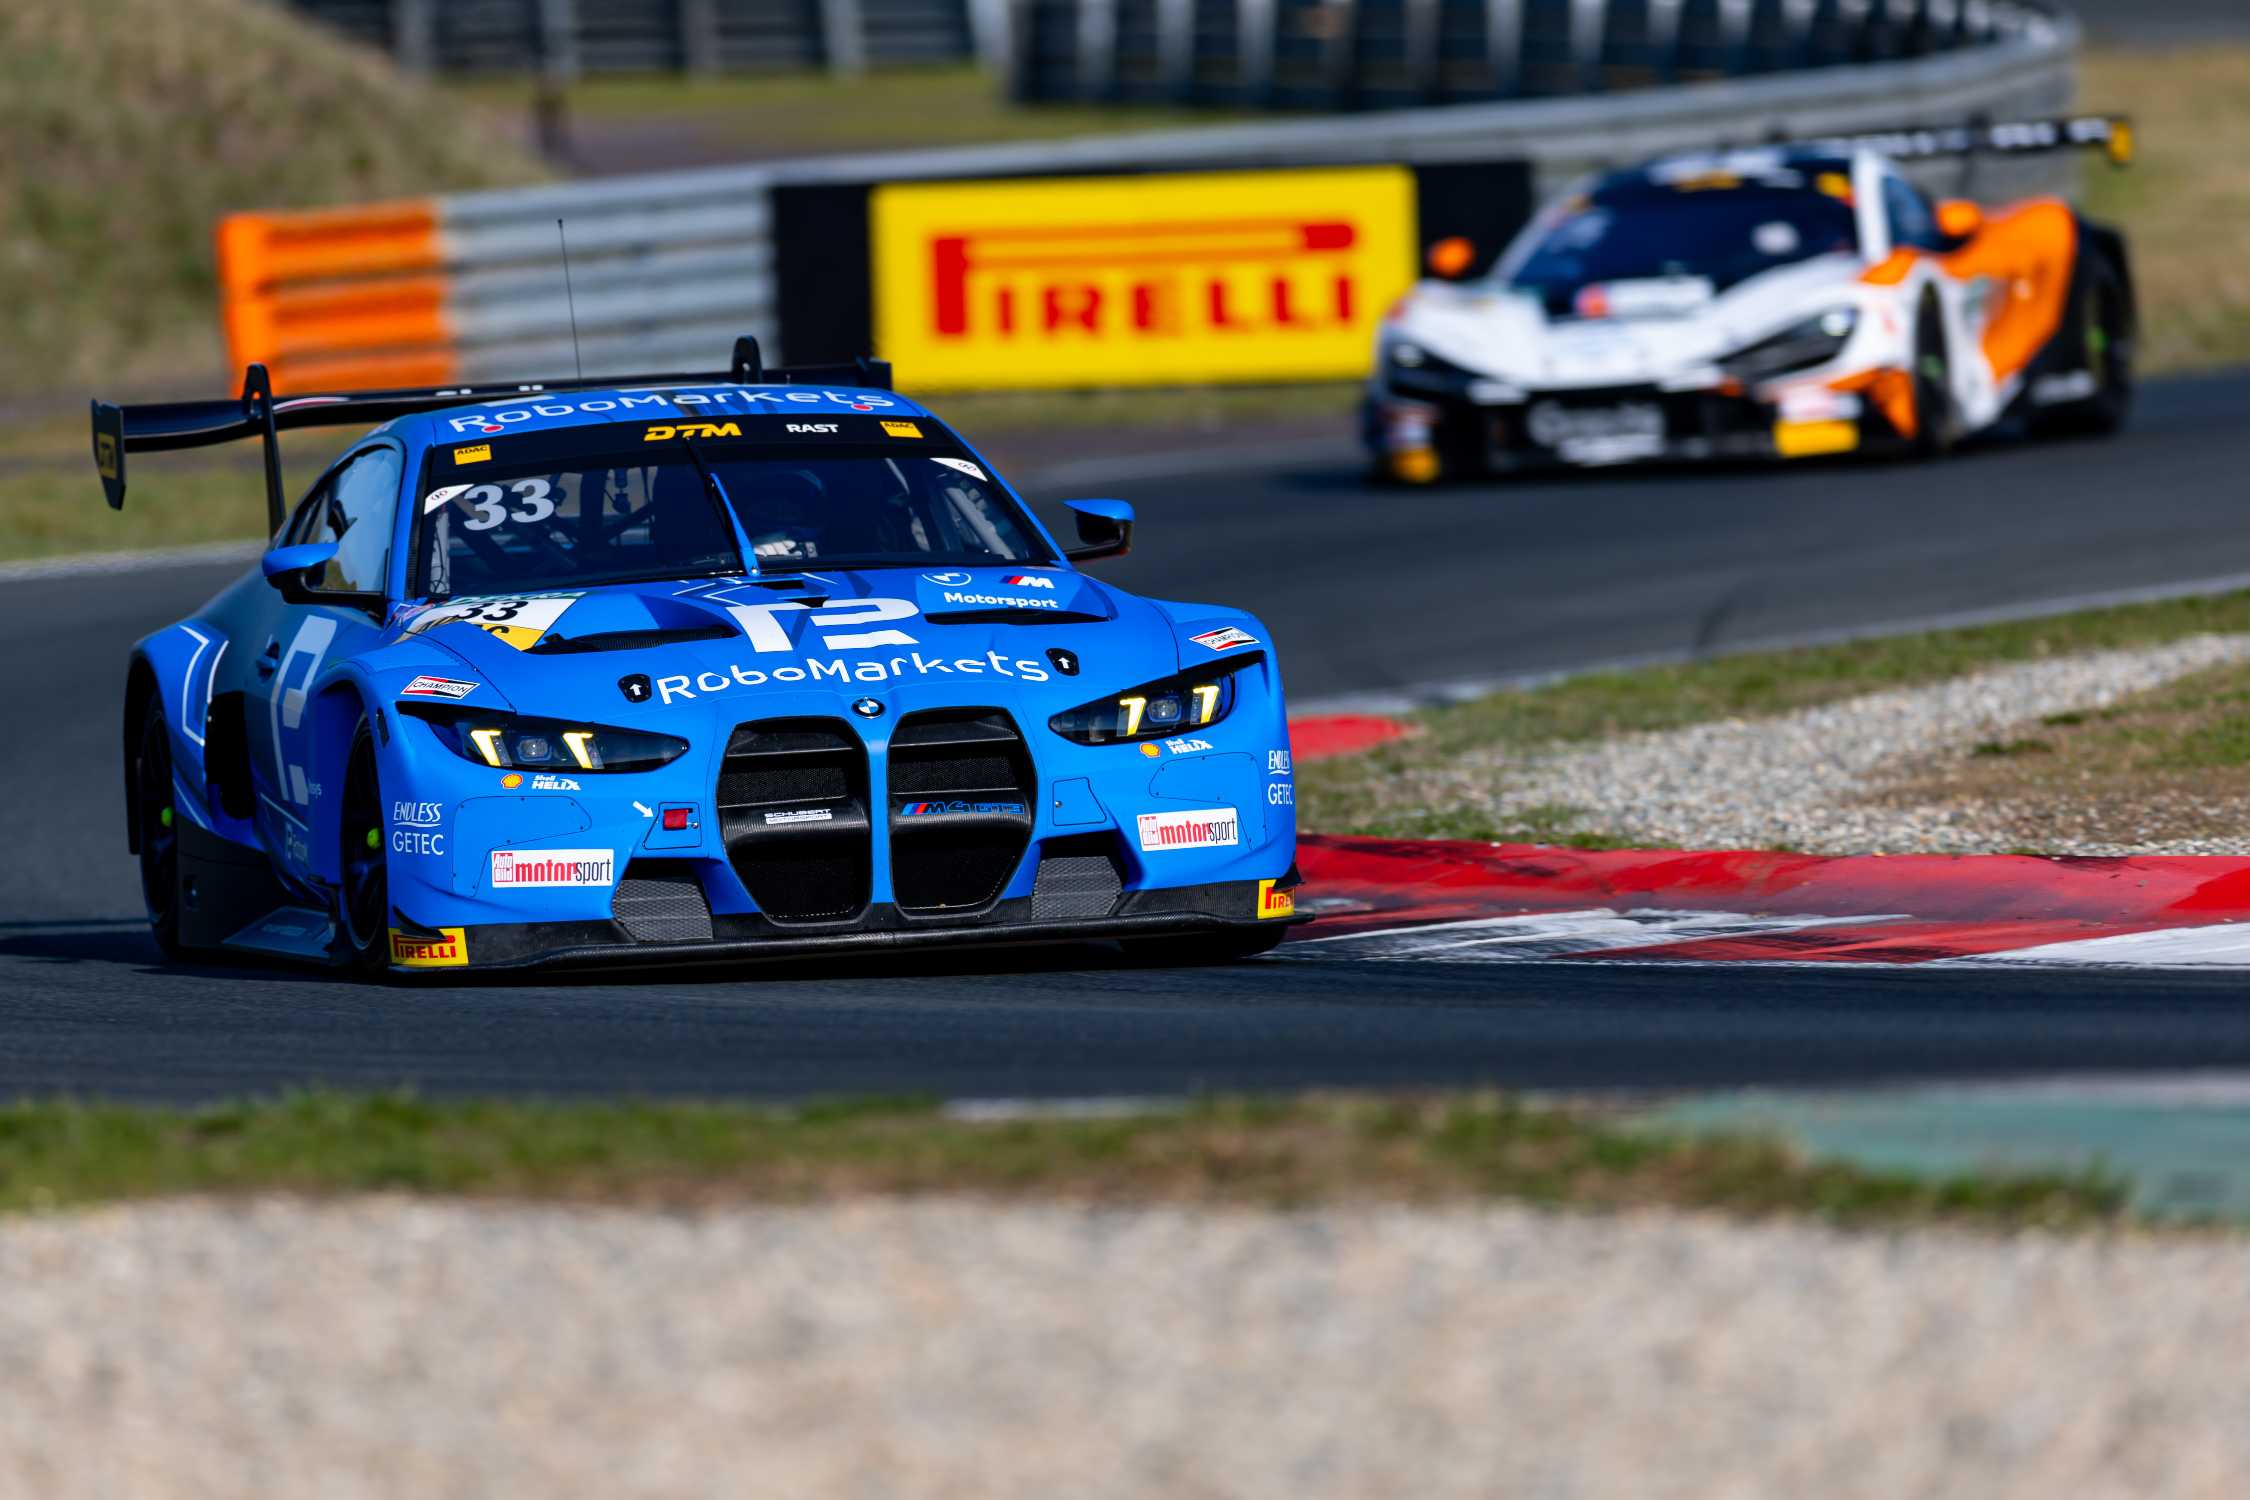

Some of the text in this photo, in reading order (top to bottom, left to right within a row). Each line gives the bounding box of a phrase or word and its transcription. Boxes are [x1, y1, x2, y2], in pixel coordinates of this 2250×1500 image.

[932, 217, 1355, 337] PIRELLI
[449, 389, 895, 434] RoboMarkets
[644, 423, 742, 441] DTM
[786, 424, 839, 433] RAST
[456, 446, 489, 455] ADAC
[464, 479, 554, 531] 33
[943, 591, 1058, 608] Motorsport
[454, 601, 529, 621] 33
[413, 681, 468, 693] CHAMPION
[657, 651, 1049, 704] RoboMarkets
[532, 778, 581, 790] HELIX
[393, 801, 443, 822] ENDLESS
[392, 831, 444, 856] GETEC
[392, 934, 456, 958] PIRELLI
